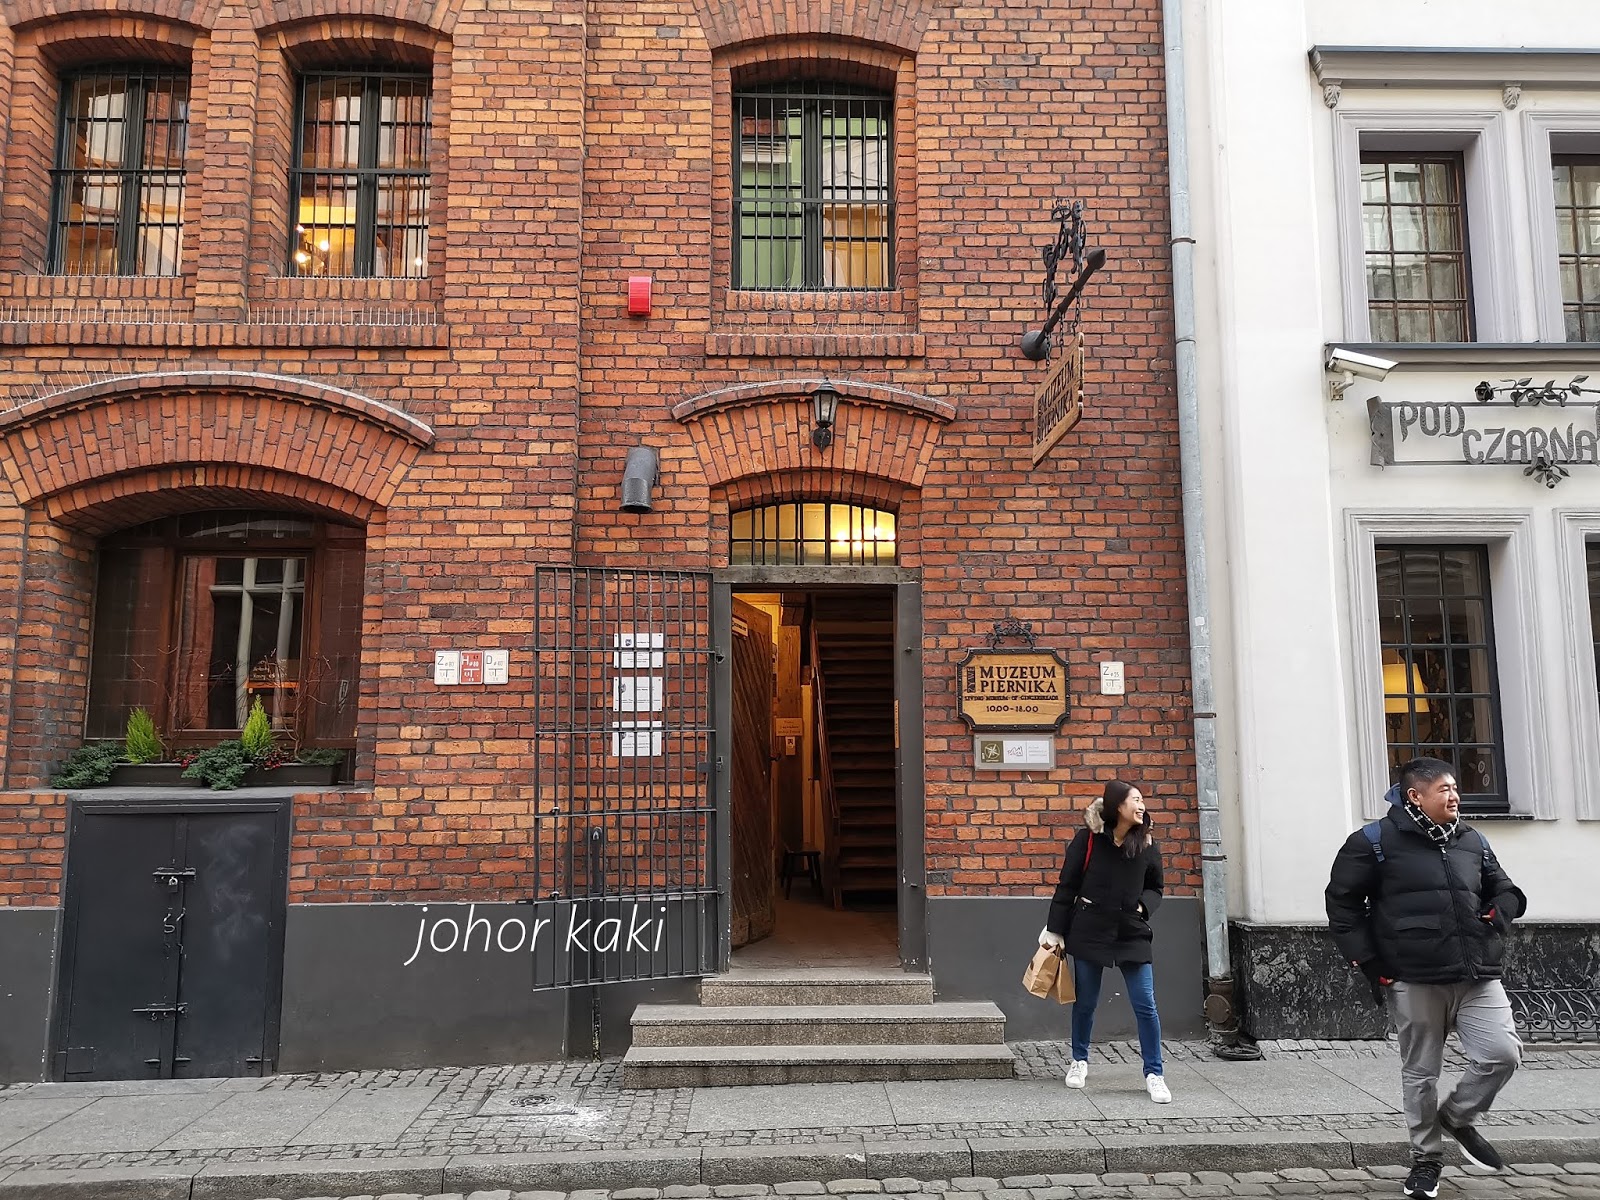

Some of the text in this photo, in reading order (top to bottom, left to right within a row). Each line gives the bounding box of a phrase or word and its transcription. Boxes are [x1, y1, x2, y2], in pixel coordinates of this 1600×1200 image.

[1394, 400, 1466, 442] POD
[437, 655, 445, 666] Z
[461, 655, 469, 666] H
[486, 655, 493, 665] D
[980, 666, 1056, 679] MUZEUM
[1103, 666, 1110, 676] Z
[980, 680, 1057, 693] PIERNIKA
